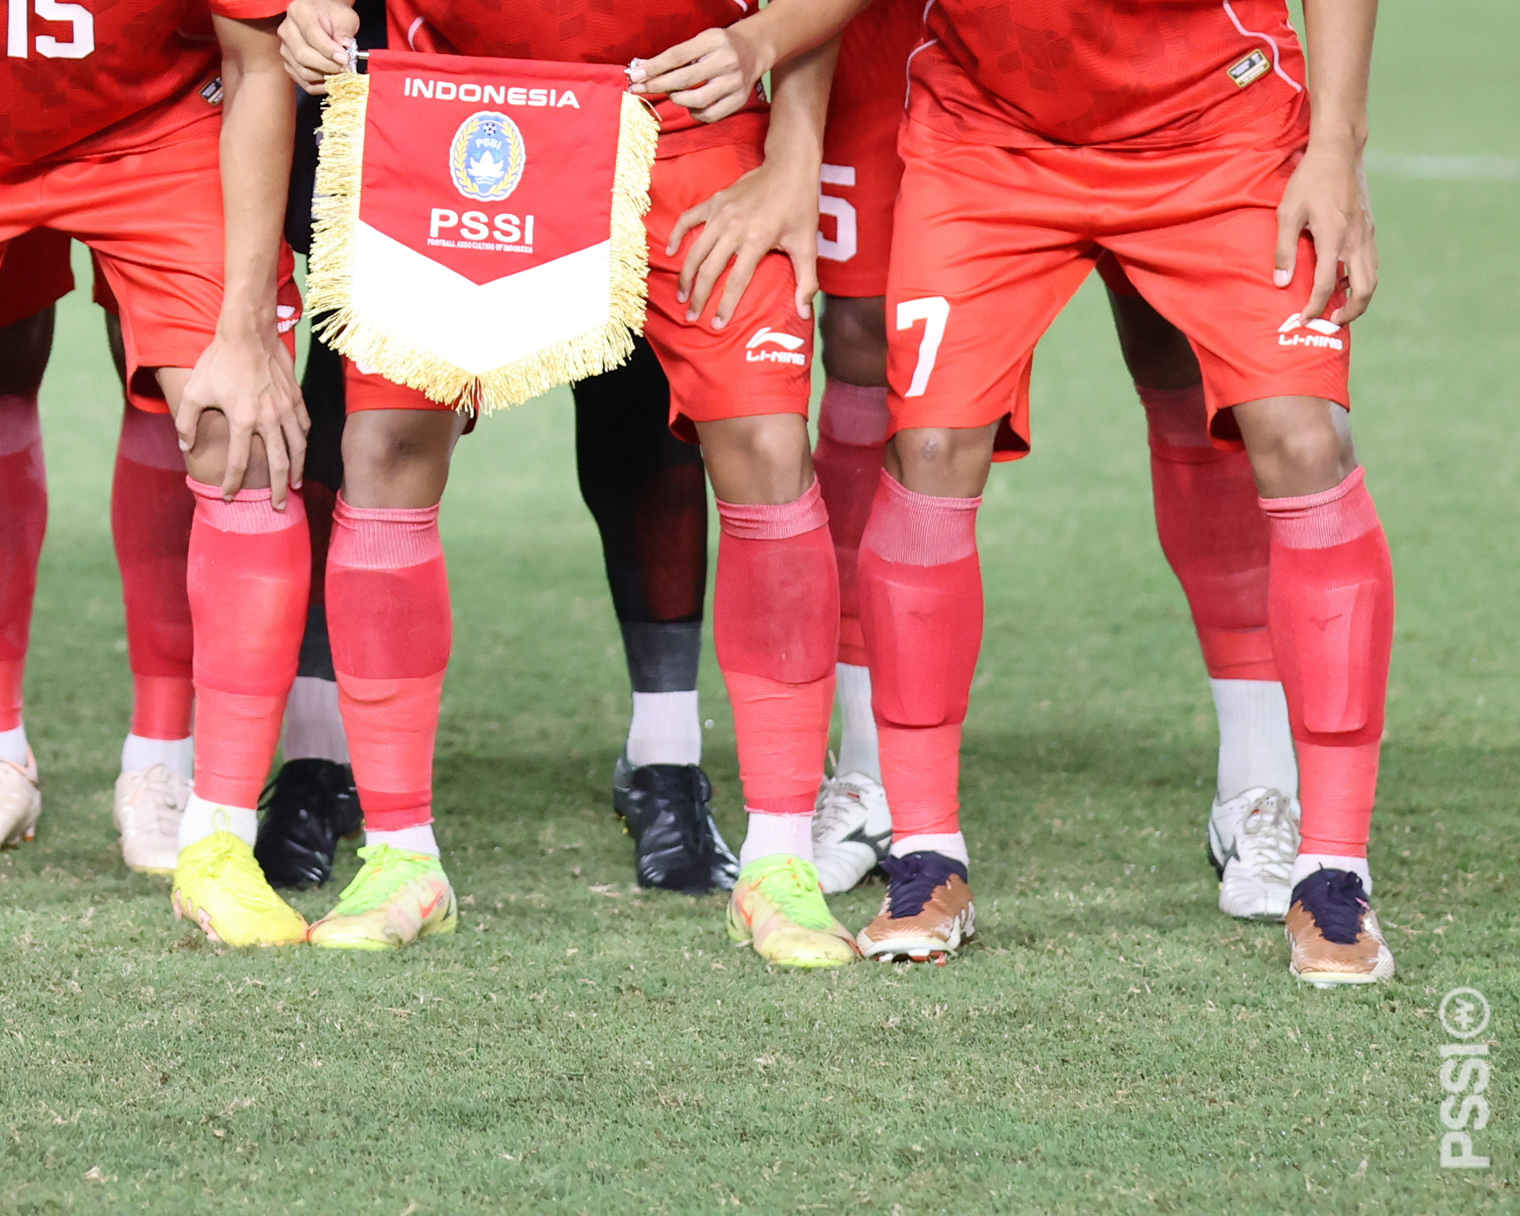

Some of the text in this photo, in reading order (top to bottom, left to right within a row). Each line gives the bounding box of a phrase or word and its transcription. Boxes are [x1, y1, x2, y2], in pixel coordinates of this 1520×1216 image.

[404, 77, 580, 109] INDONESIA
[475, 137, 502, 150] PSSI
[429, 208, 534, 245] PSSI
[896, 296, 951, 398] 7
[1277, 334, 1344, 351] LI-NING
[745, 350, 806, 366] LI-NING
